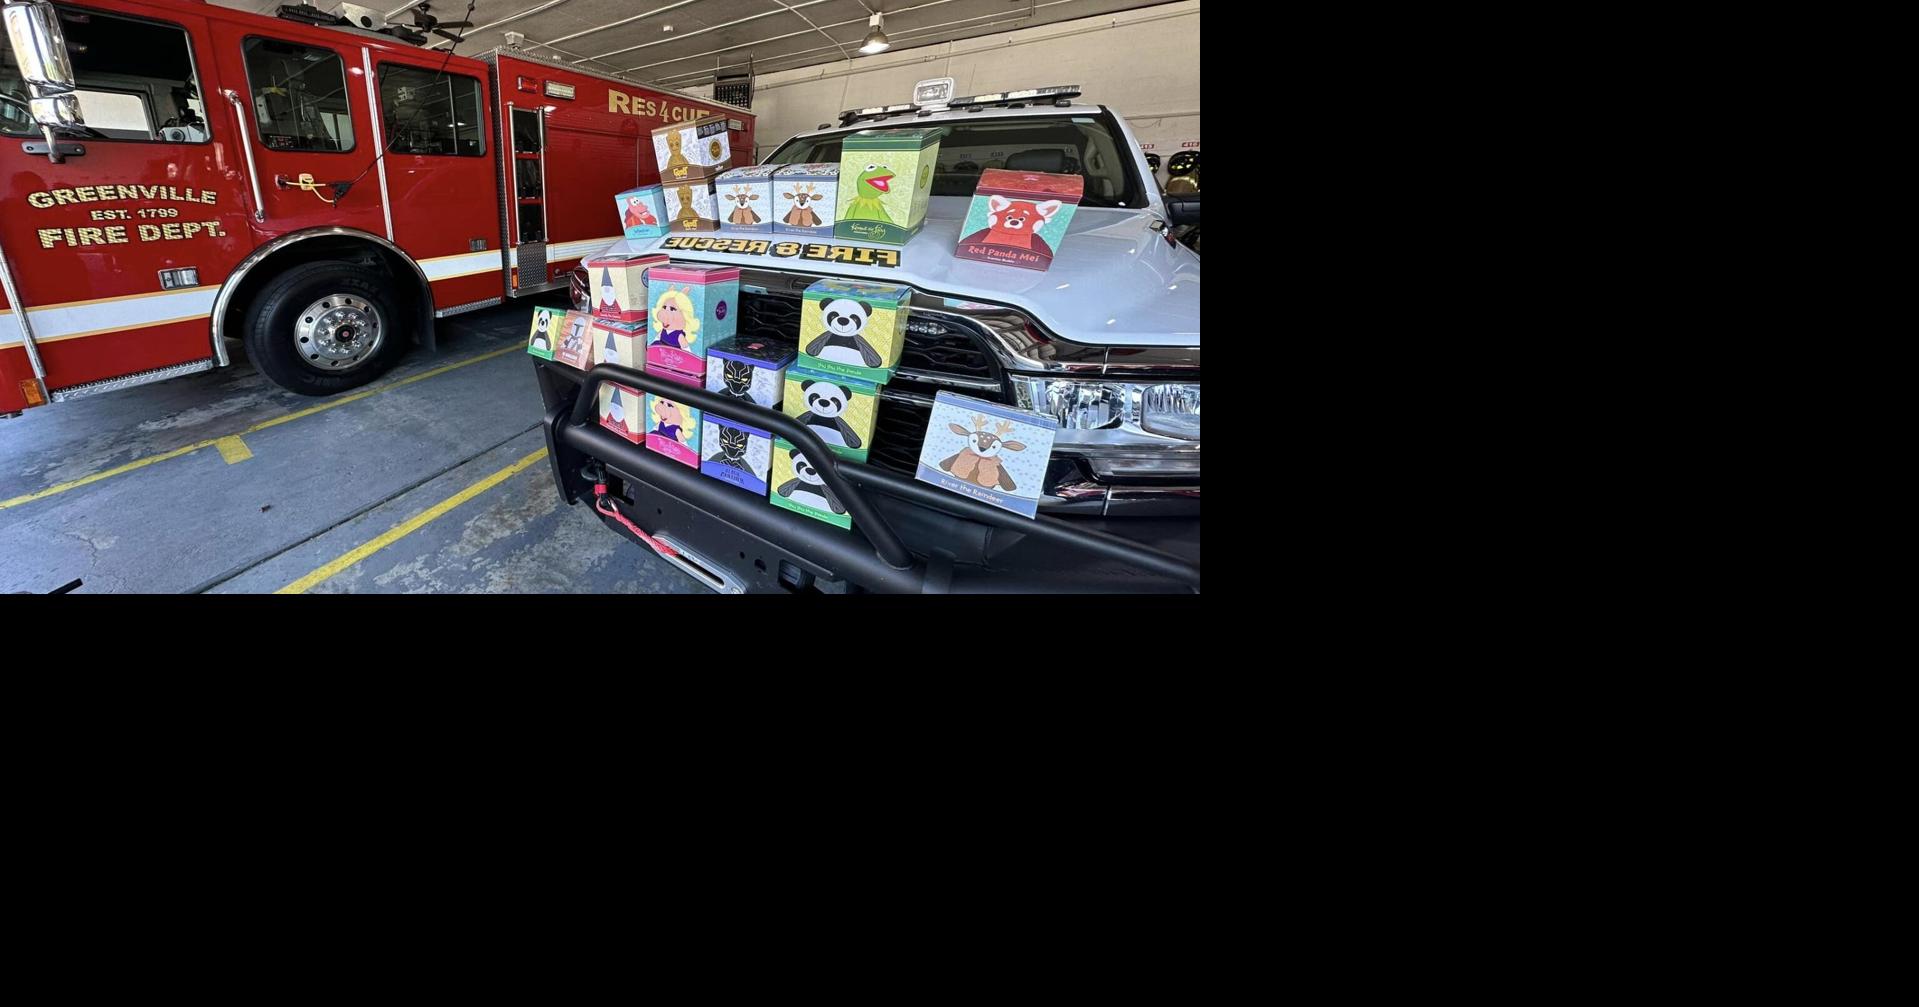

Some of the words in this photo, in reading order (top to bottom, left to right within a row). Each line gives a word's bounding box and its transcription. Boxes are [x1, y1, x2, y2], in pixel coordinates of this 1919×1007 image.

[28, 184, 217, 208] GREENVILLE
[91, 209, 132, 221] EST.
[138, 208, 178, 218] 1799
[38, 225, 129, 249] FIRE
[138, 221, 226, 242] DEPT.
[968, 245, 985, 254] Red
[988, 248, 1017, 259] Panda
[1019, 253, 1041, 262] Mei
